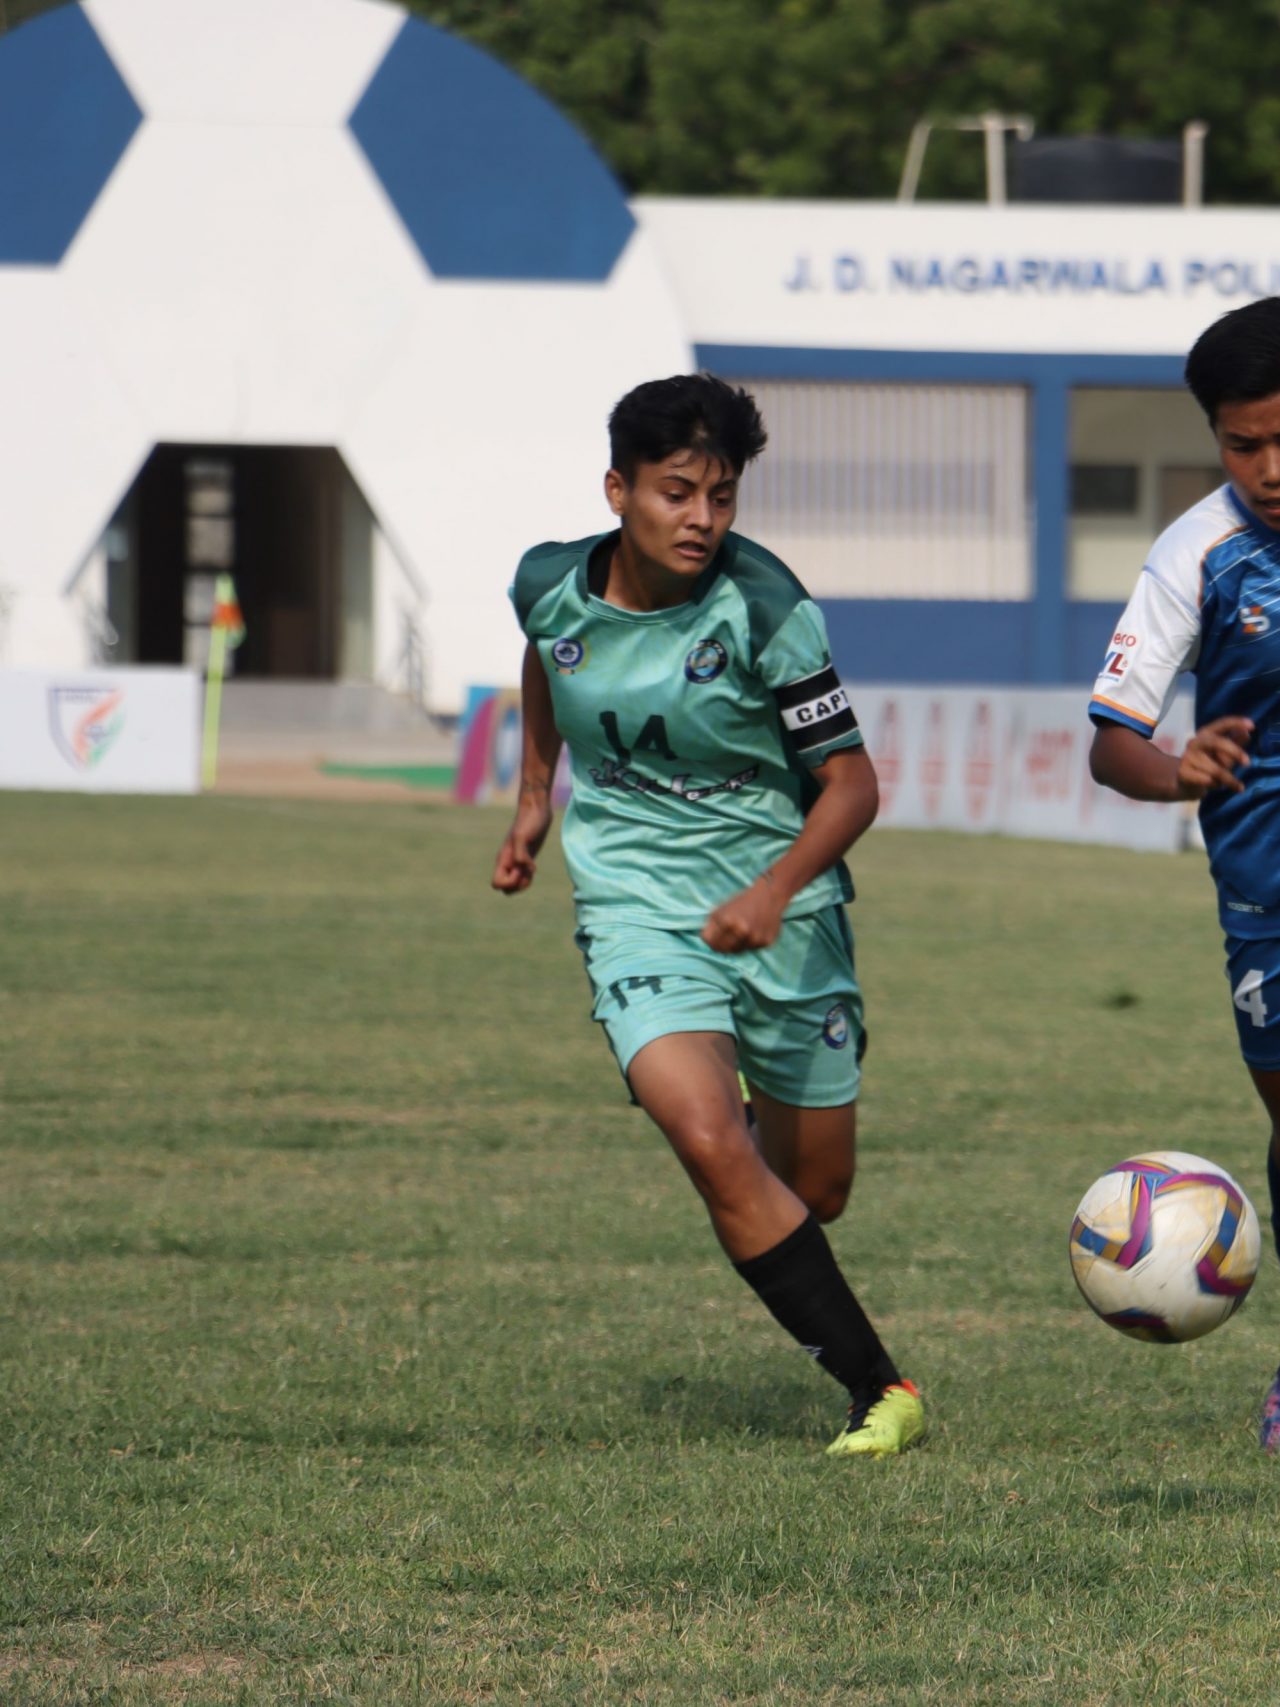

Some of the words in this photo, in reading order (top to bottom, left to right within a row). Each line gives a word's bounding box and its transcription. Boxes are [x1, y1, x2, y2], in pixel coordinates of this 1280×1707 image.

[890, 256, 1168, 296] NAGARWALA
[598, 710, 679, 767] 14
[1233, 968, 1268, 1028] 4
